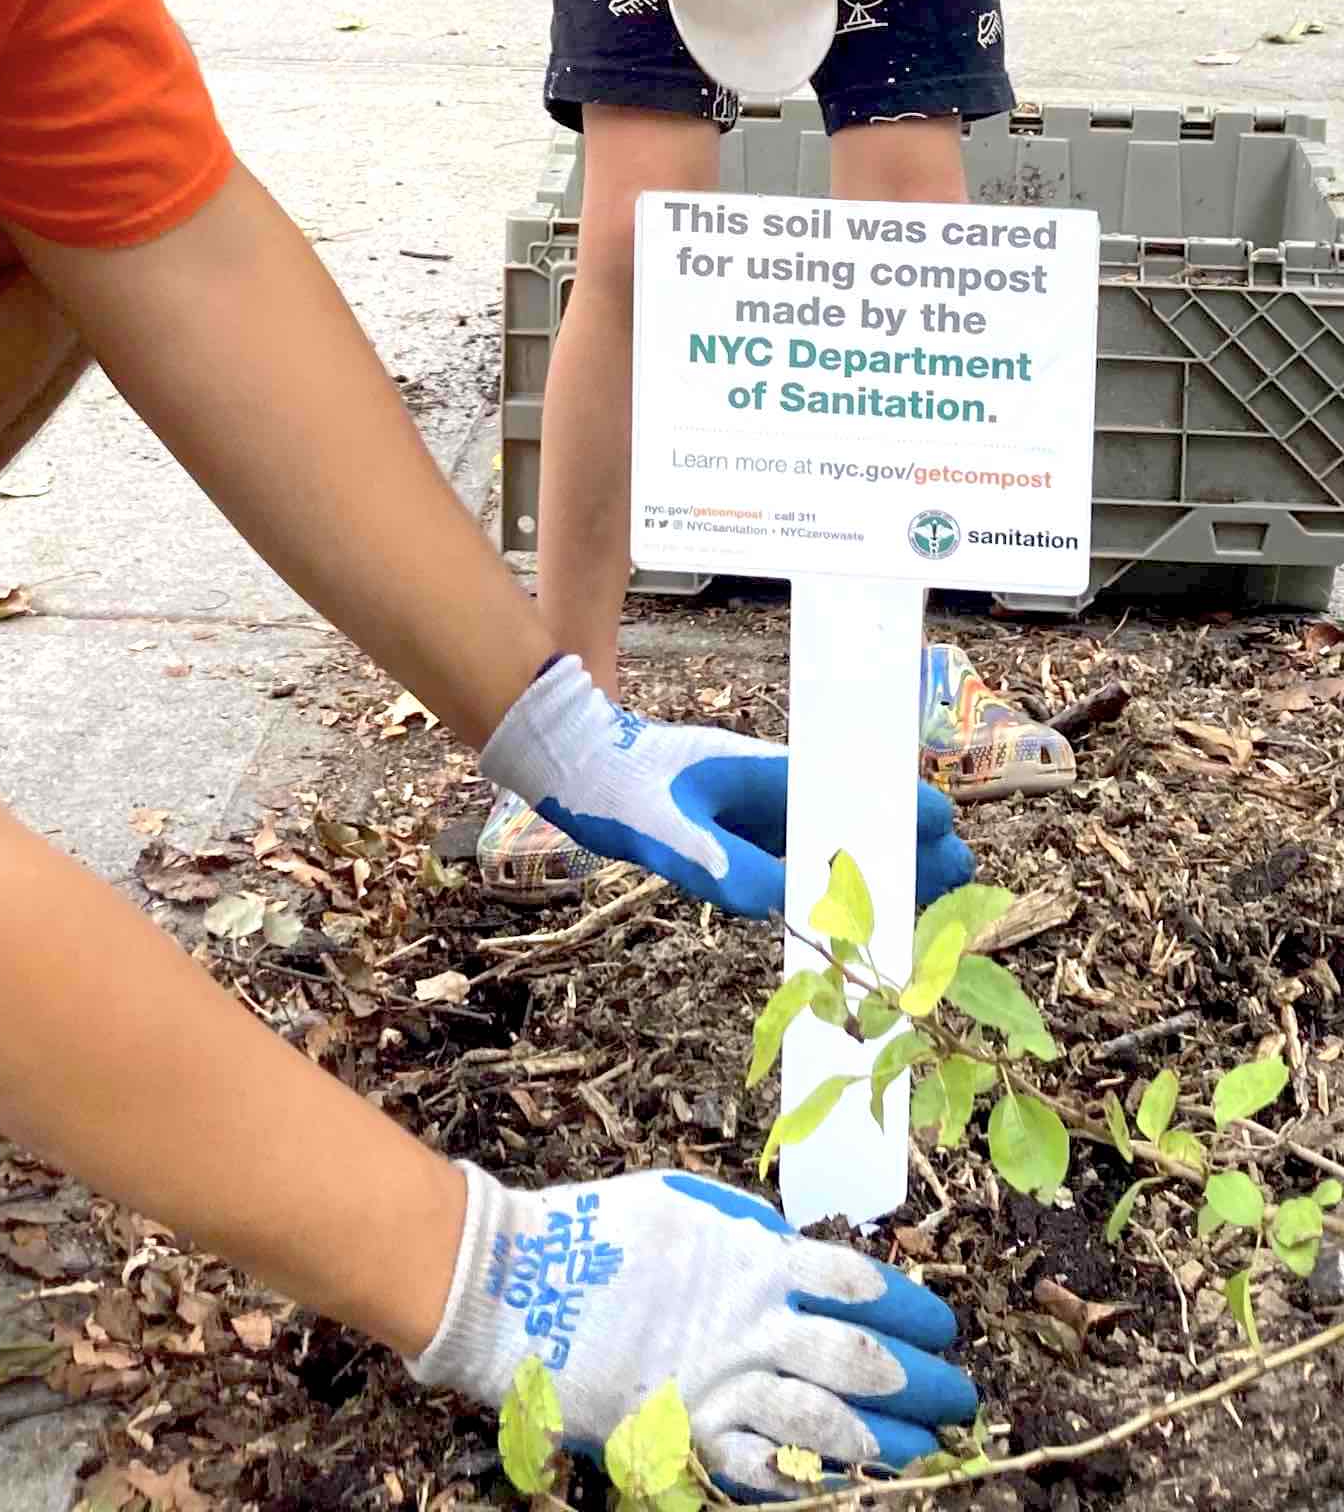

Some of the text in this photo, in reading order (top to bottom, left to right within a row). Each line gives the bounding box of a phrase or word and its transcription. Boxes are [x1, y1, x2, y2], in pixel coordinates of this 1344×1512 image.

[664, 202, 1057, 250] This soil was cared
[676, 246, 1048, 297] for using compost
[736, 296, 987, 337] made by the
[689, 333, 1032, 382] NYC Department
[727, 380, 998, 424] of Sanitation.
[672, 447, 1052, 490] Learn more at nyc.gov/getcompost
[686, 520, 865, 542] NYCsanitation NYCzerowaste
[774, 511, 795, 522] call
[798, 512, 817, 523] 311
[967, 528, 1079, 551] sanitation
[504, 1231, 545, 1309] 300
[525, 1211, 573, 1337] ATLAS
